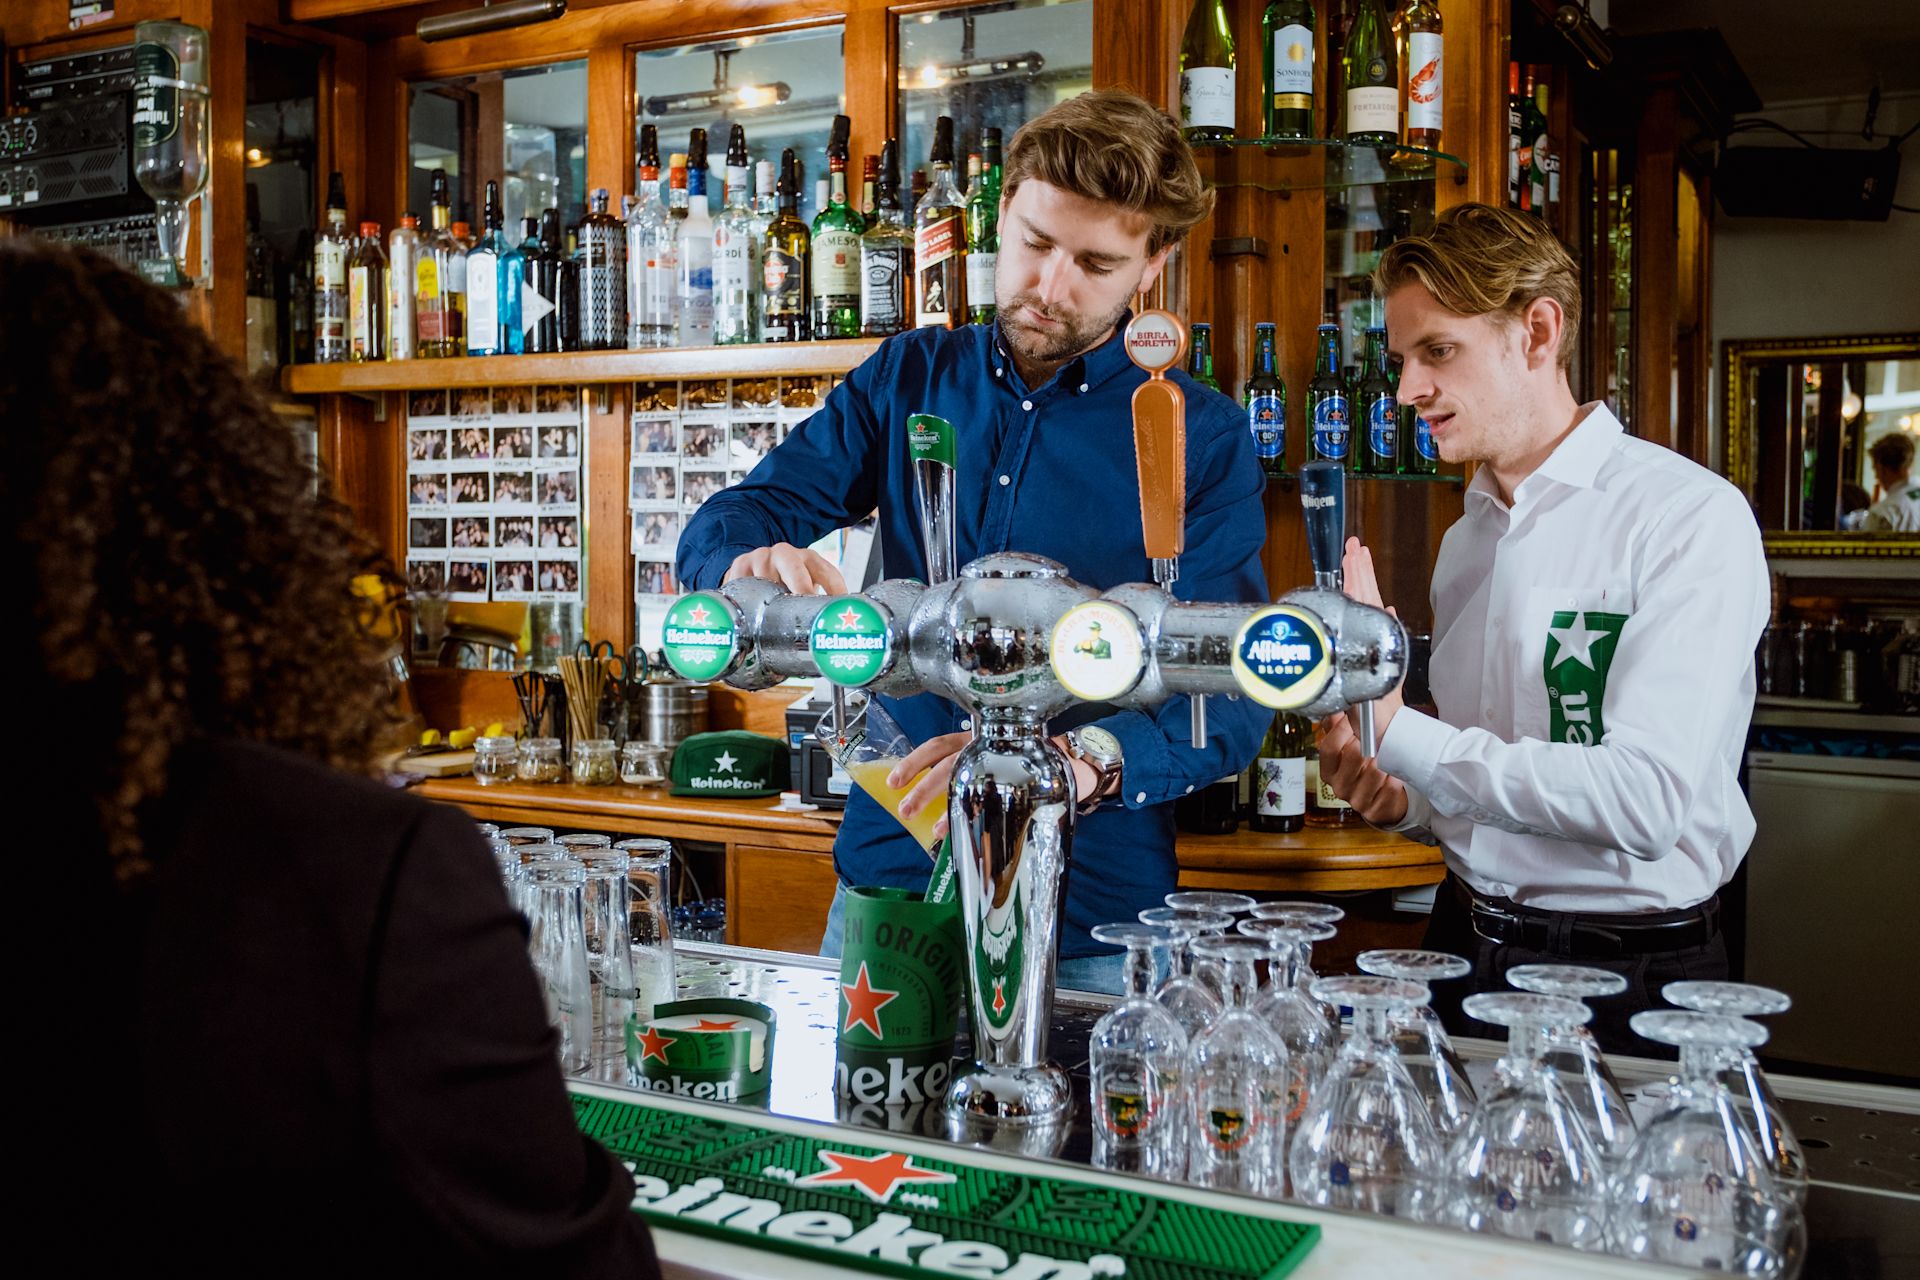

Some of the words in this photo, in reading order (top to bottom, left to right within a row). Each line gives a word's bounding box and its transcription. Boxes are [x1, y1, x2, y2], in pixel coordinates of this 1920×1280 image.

[817, 236, 858, 250] JAMESO
[666, 629, 732, 645] Heineken
[815, 634, 884, 649] Heineken
[1258, 665, 1304, 675] BLOND
[691, 776, 766, 790] Heineken
